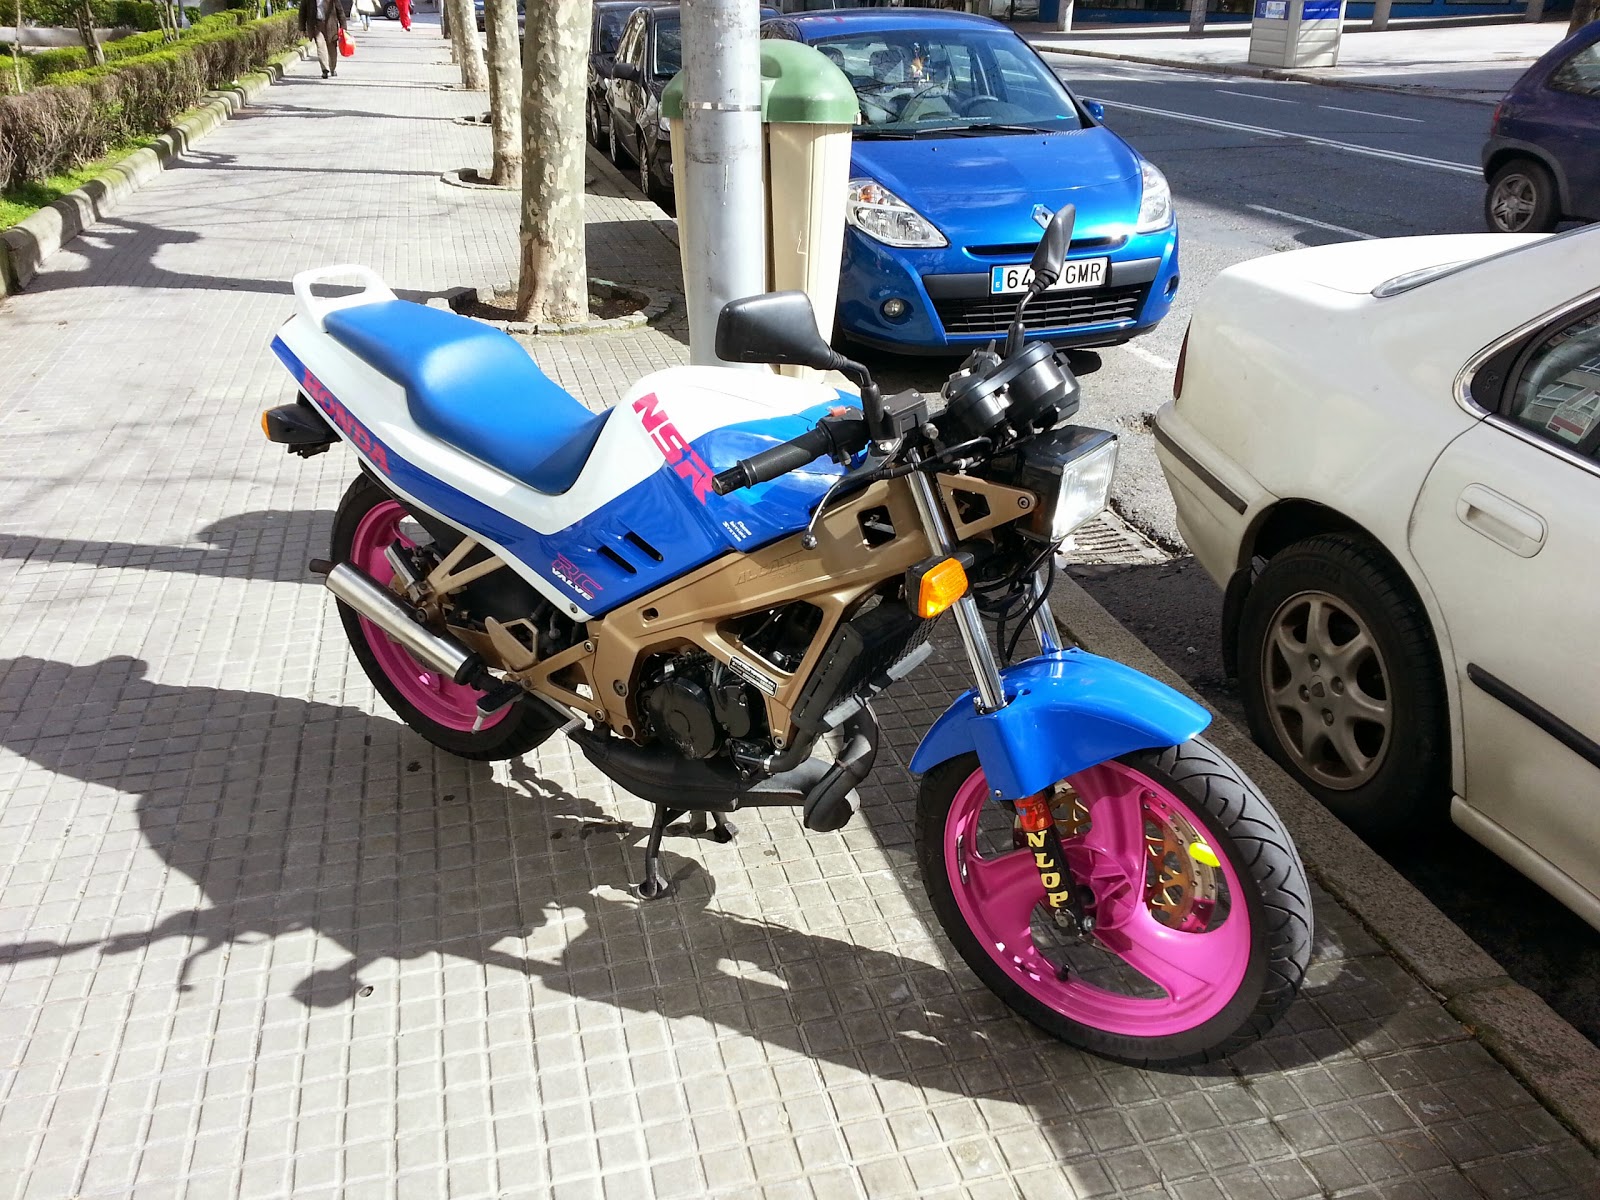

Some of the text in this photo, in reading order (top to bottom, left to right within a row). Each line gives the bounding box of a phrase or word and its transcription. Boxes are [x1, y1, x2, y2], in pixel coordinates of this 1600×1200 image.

[1065, 263, 1101, 284] GMR
[303, 368, 391, 475] HONDA
[632, 392, 715, 506] NSR
[552, 552, 604, 599] RC
[552, 567, 593, 600] VALVE
